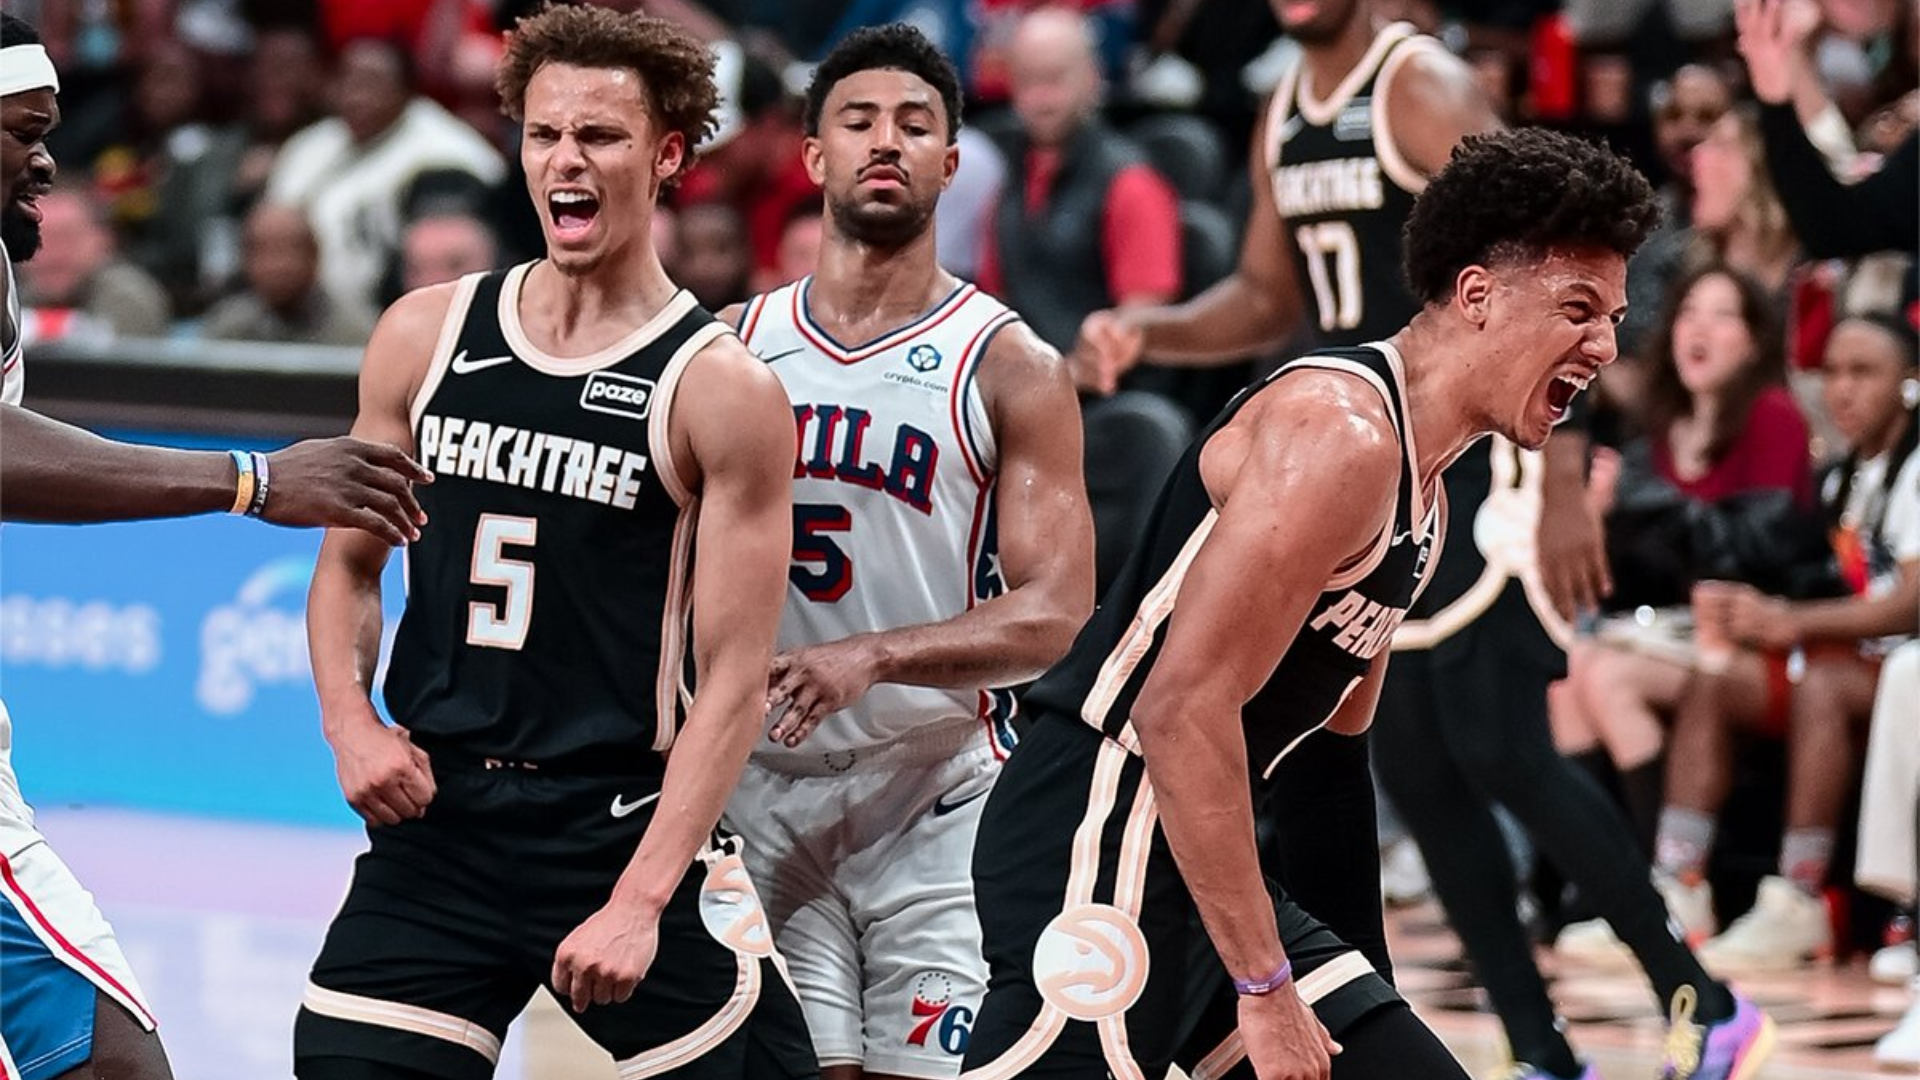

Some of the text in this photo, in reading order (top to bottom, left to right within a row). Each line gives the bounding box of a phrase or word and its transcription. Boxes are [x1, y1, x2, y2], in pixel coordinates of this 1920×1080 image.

[1296, 221, 1362, 331] 17
[589, 381, 647, 405] paze
[884, 372, 948, 393] crypto.com
[421, 415, 647, 510] PEACHTREE
[466, 513, 538, 650] 5
[906, 995, 973, 1056] 76
